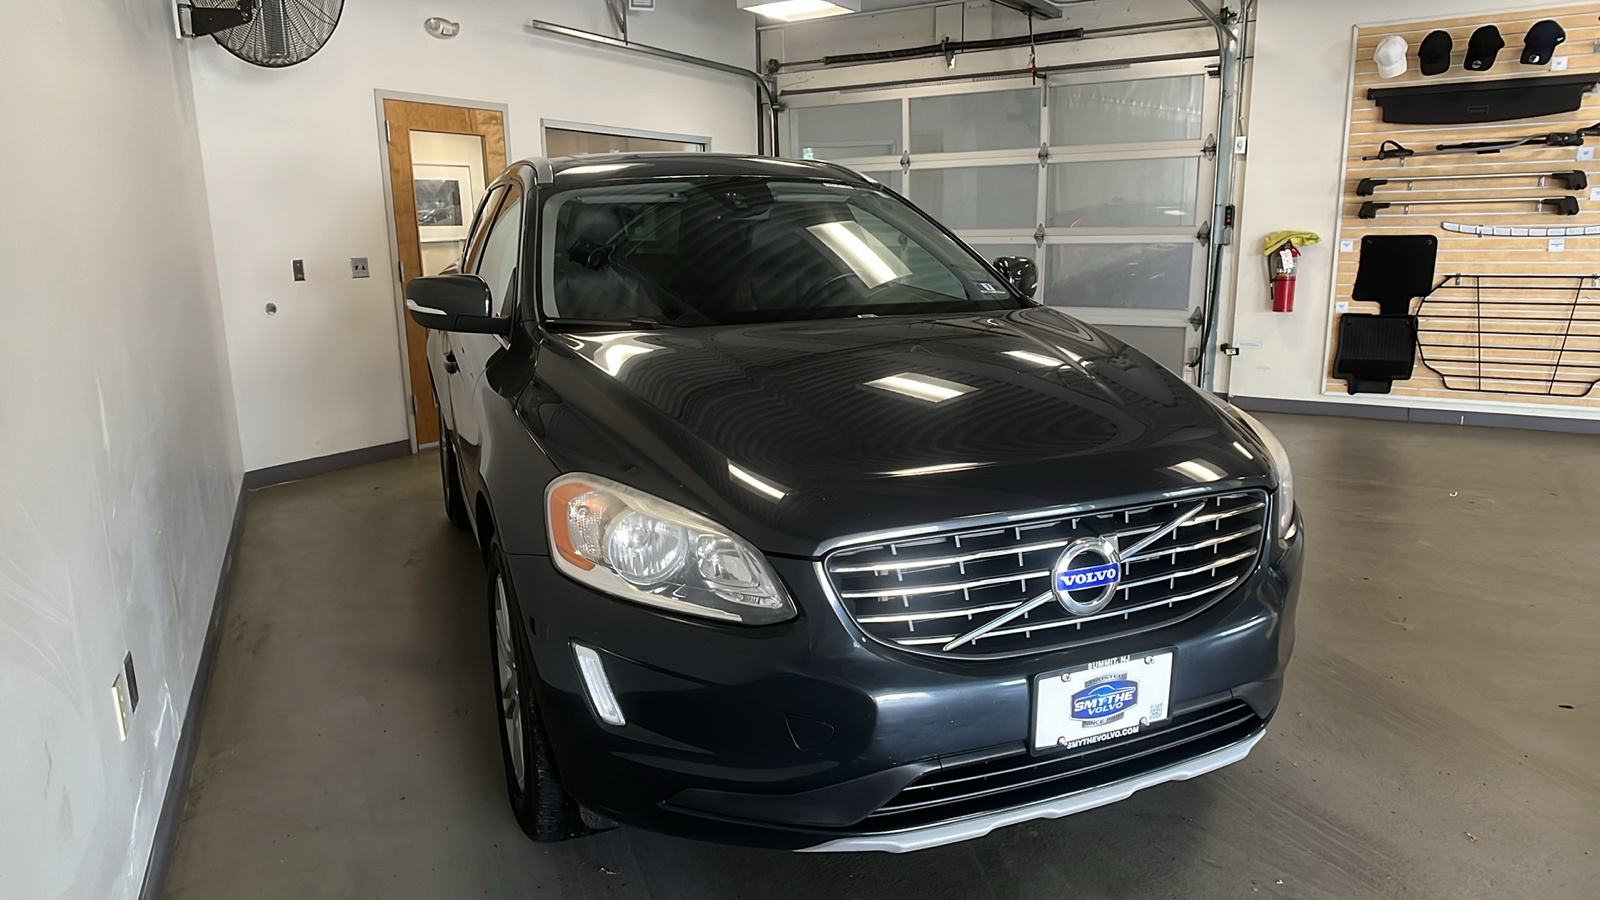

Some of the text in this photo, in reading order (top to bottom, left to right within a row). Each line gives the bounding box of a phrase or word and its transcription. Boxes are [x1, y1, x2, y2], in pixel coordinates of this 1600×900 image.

[1060, 568, 1116, 586] VOLVO
[1120, 655, 1131, 663] NJ
[1074, 690, 1135, 712] SMYTHE
[1087, 702, 1124, 716] VOLVO
[1067, 725, 1140, 749] SMYTHEVOLVO.COM
